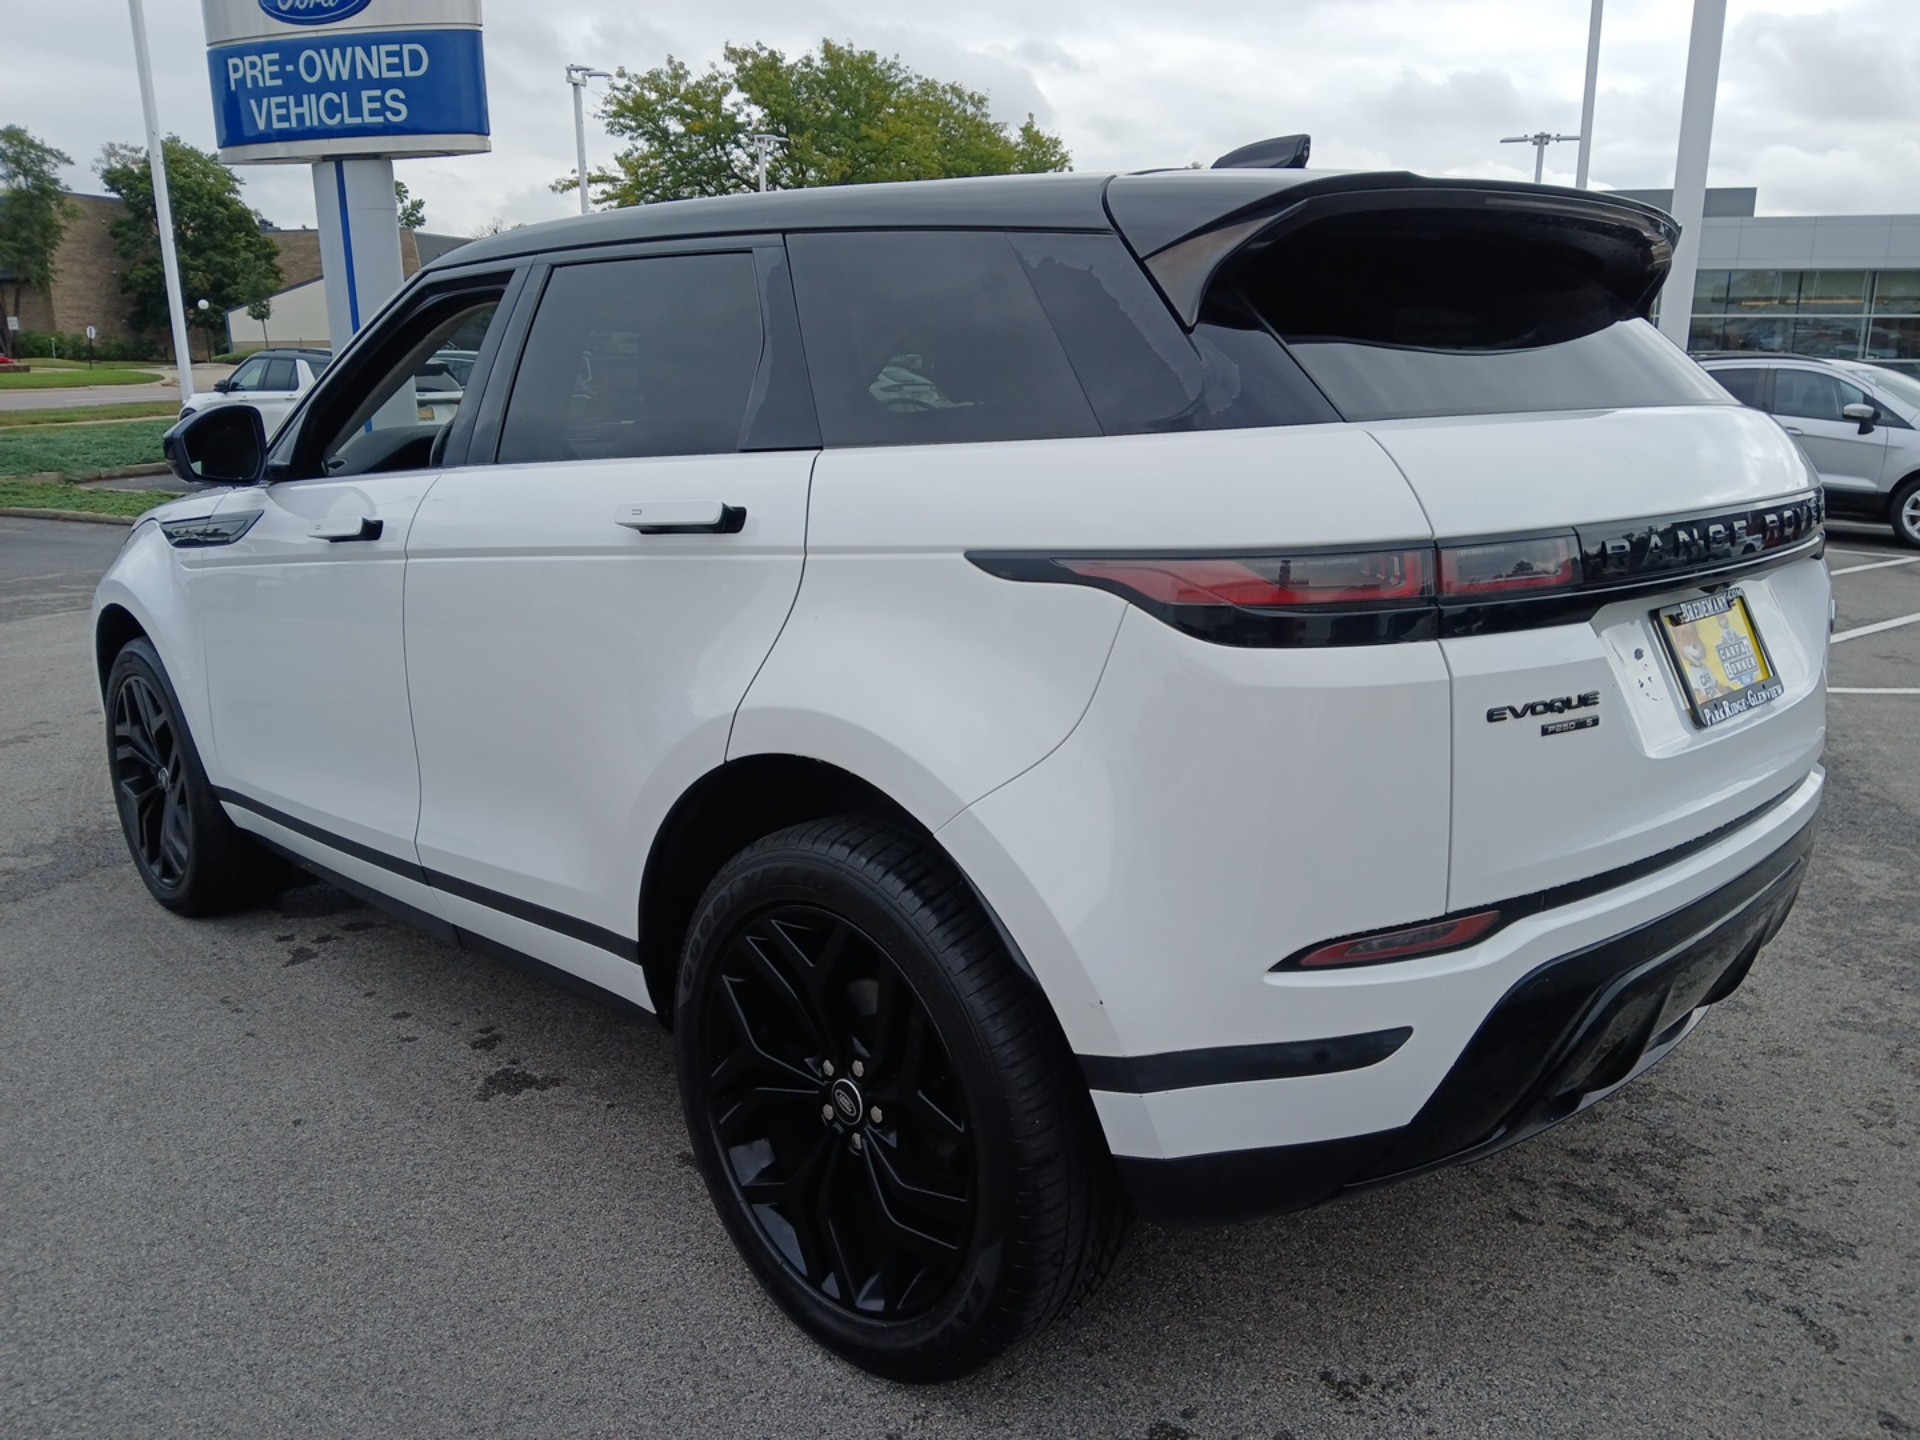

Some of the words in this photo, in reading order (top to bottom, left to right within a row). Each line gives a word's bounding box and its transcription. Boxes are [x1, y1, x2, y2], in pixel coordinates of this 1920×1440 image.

[227, 43, 430, 91] PRE-OWNED
[249, 88, 408, 130] VEHICLES
[1601, 519, 1750, 568] RANGE
[1763, 497, 1823, 541] ROVE
[1486, 690, 1600, 723] EVOQUE
